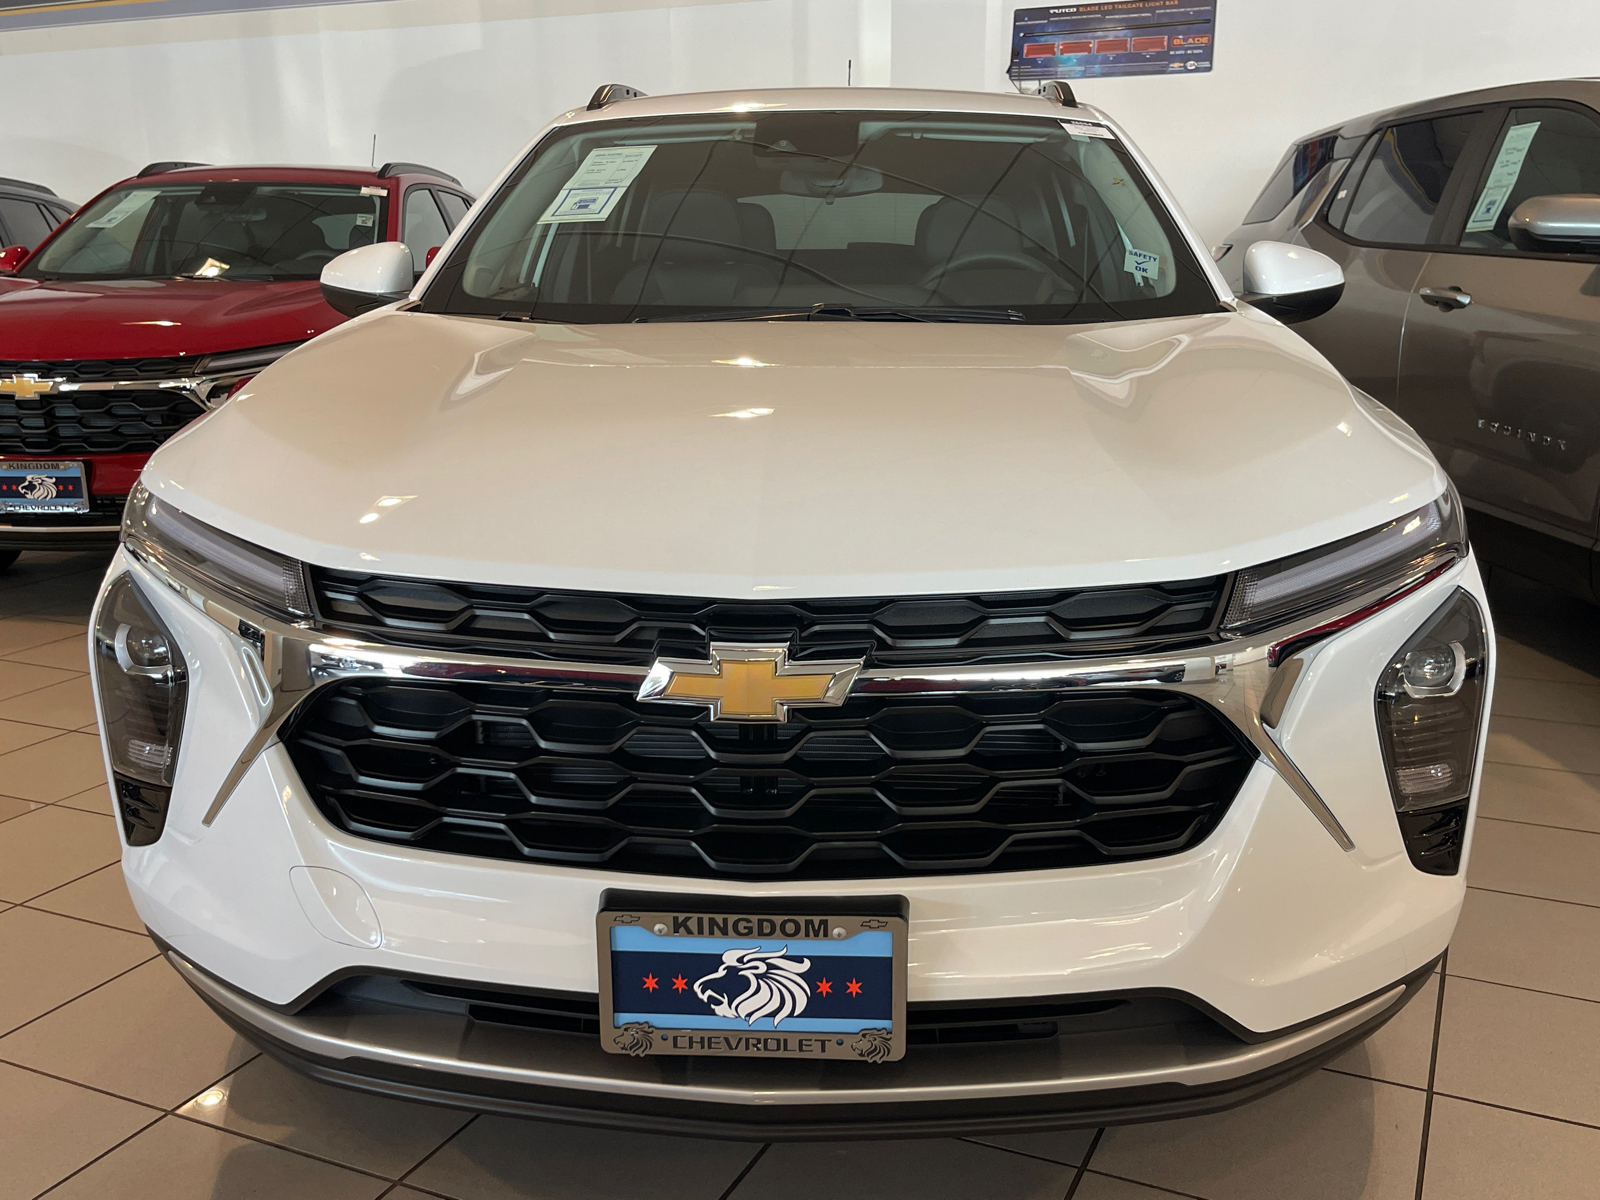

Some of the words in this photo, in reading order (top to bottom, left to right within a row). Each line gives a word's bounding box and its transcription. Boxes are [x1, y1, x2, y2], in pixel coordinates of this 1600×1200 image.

[1173, 37, 1209, 45] BLADE
[1128, 250, 1158, 263] SAFETY
[1134, 265, 1149, 274] OK
[1477, 418, 1567, 451] EQUINOX
[8, 462, 60, 470] KINGDOM
[13, 504, 65, 512] CHEVROLET
[672, 915, 829, 938] KINGDOM
[672, 1034, 832, 1054] CHEVROLET
